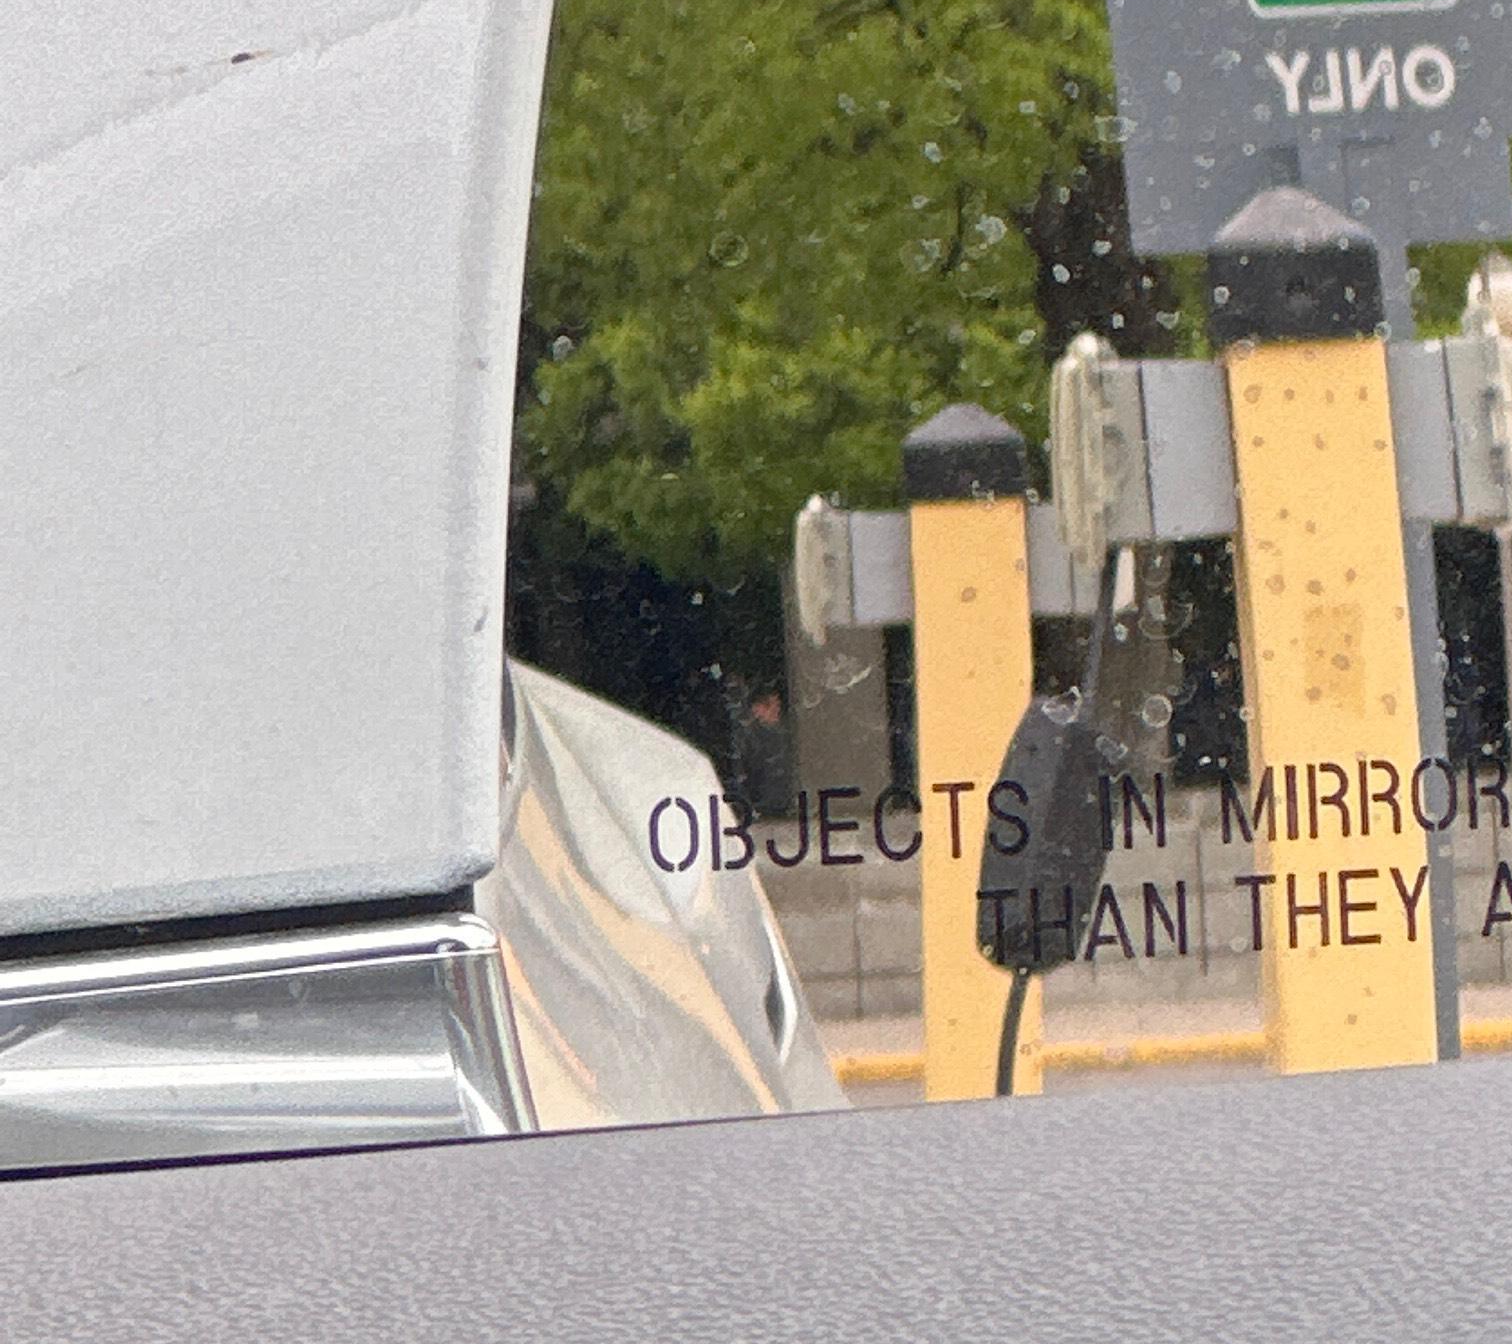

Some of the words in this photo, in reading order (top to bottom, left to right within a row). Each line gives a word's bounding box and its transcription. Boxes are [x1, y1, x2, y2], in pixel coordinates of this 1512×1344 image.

[648, 779, 1030, 873] OBJECTS
[1102, 772, 1166, 852] IN
[1219, 759, 1510, 845] MIRROR
[976, 879, 1190, 962] THAN
[1234, 864, 1430, 952] THEY
